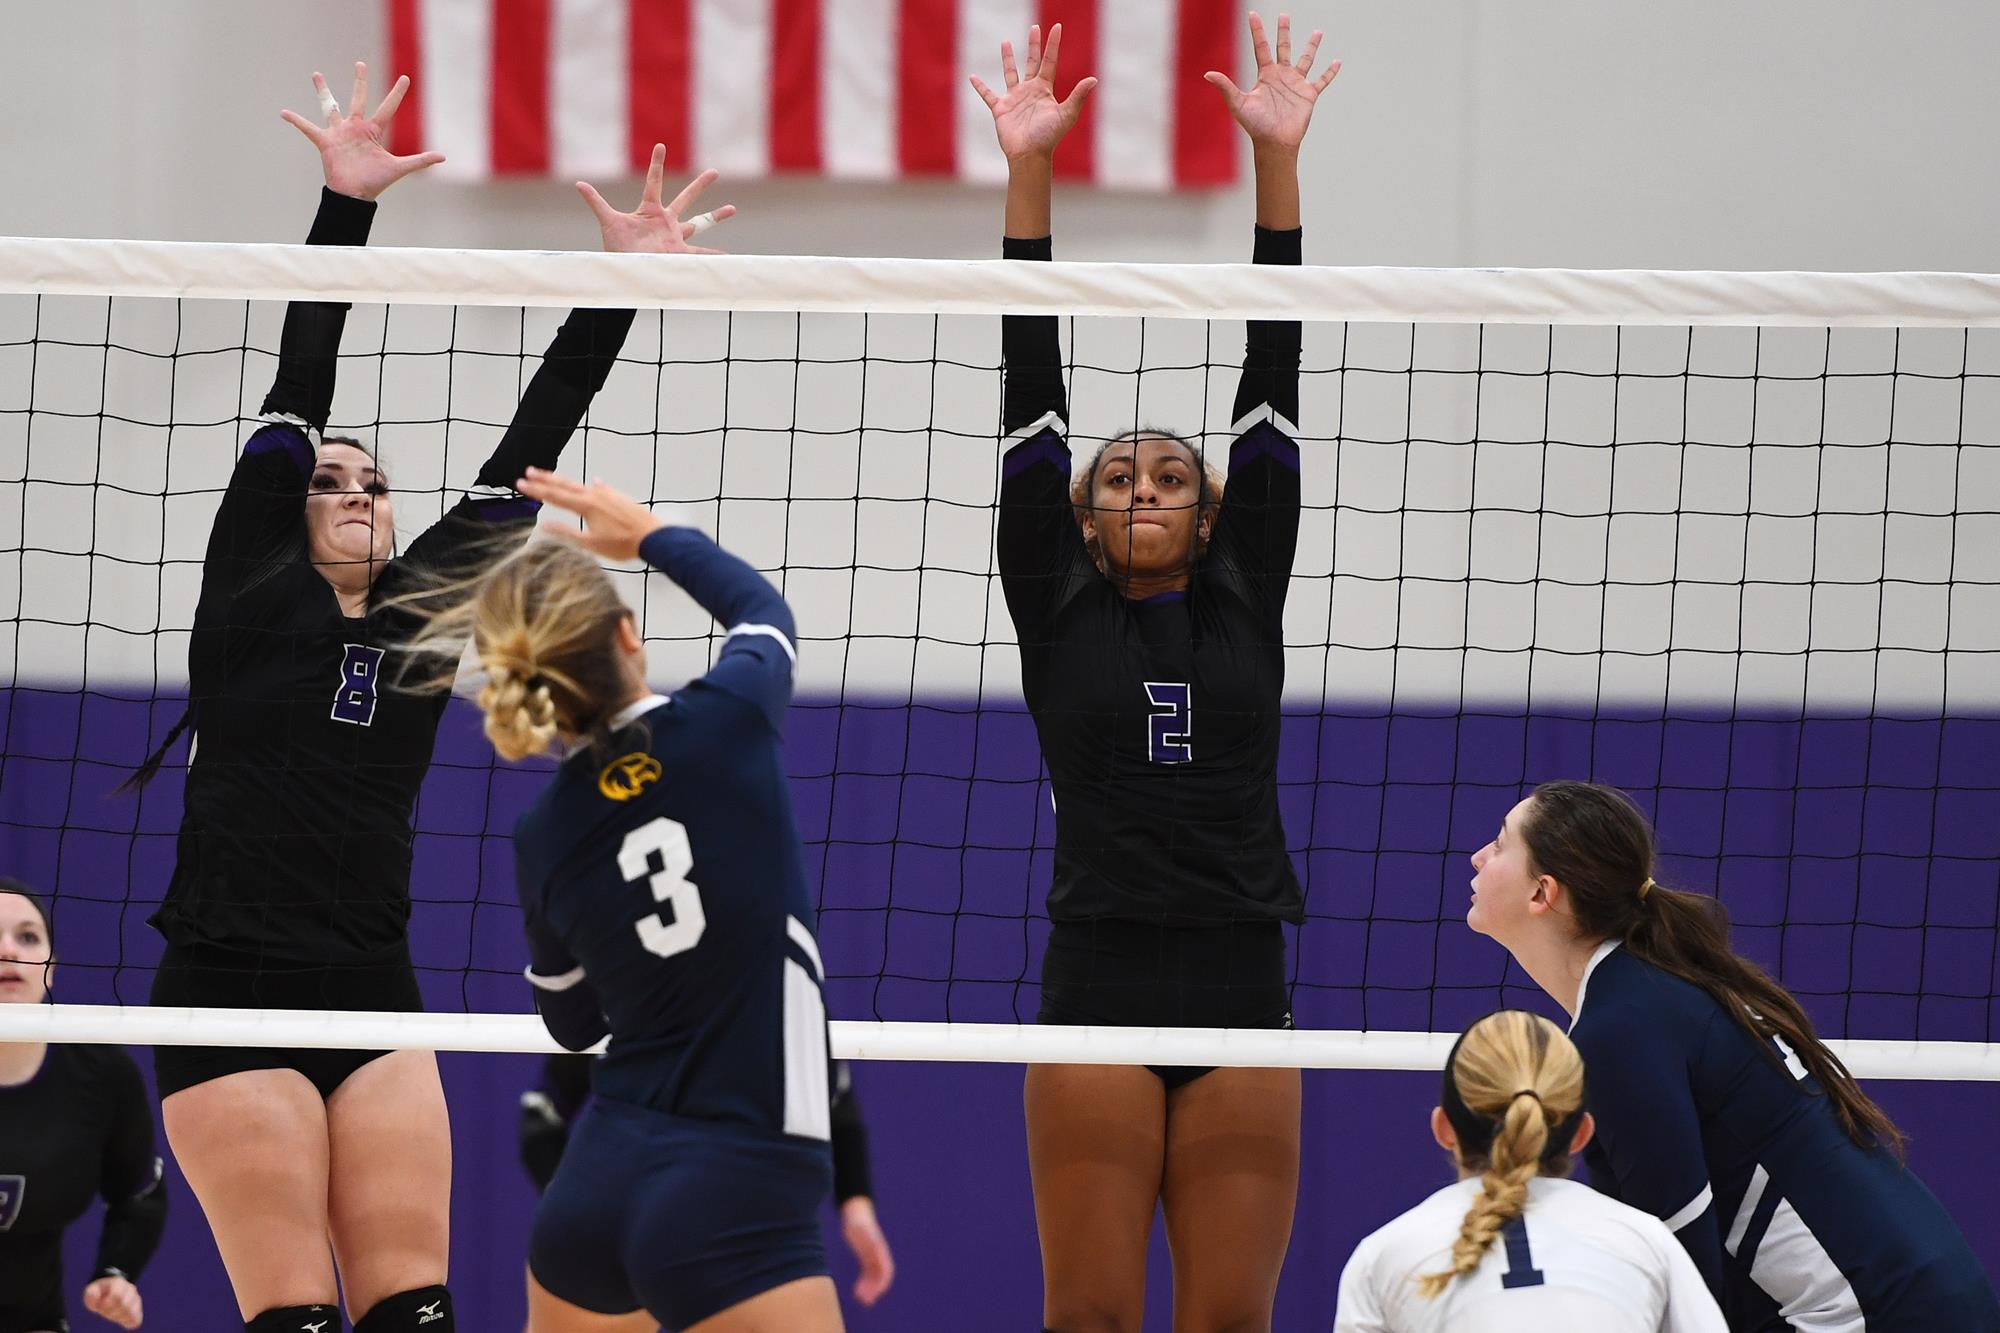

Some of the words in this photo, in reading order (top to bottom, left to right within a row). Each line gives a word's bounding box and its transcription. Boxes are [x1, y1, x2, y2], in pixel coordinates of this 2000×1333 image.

[331, 643, 385, 727] 8
[1143, 681, 1192, 764] 2
[616, 816, 707, 957] 3
[1500, 1210, 1545, 1290] 1
